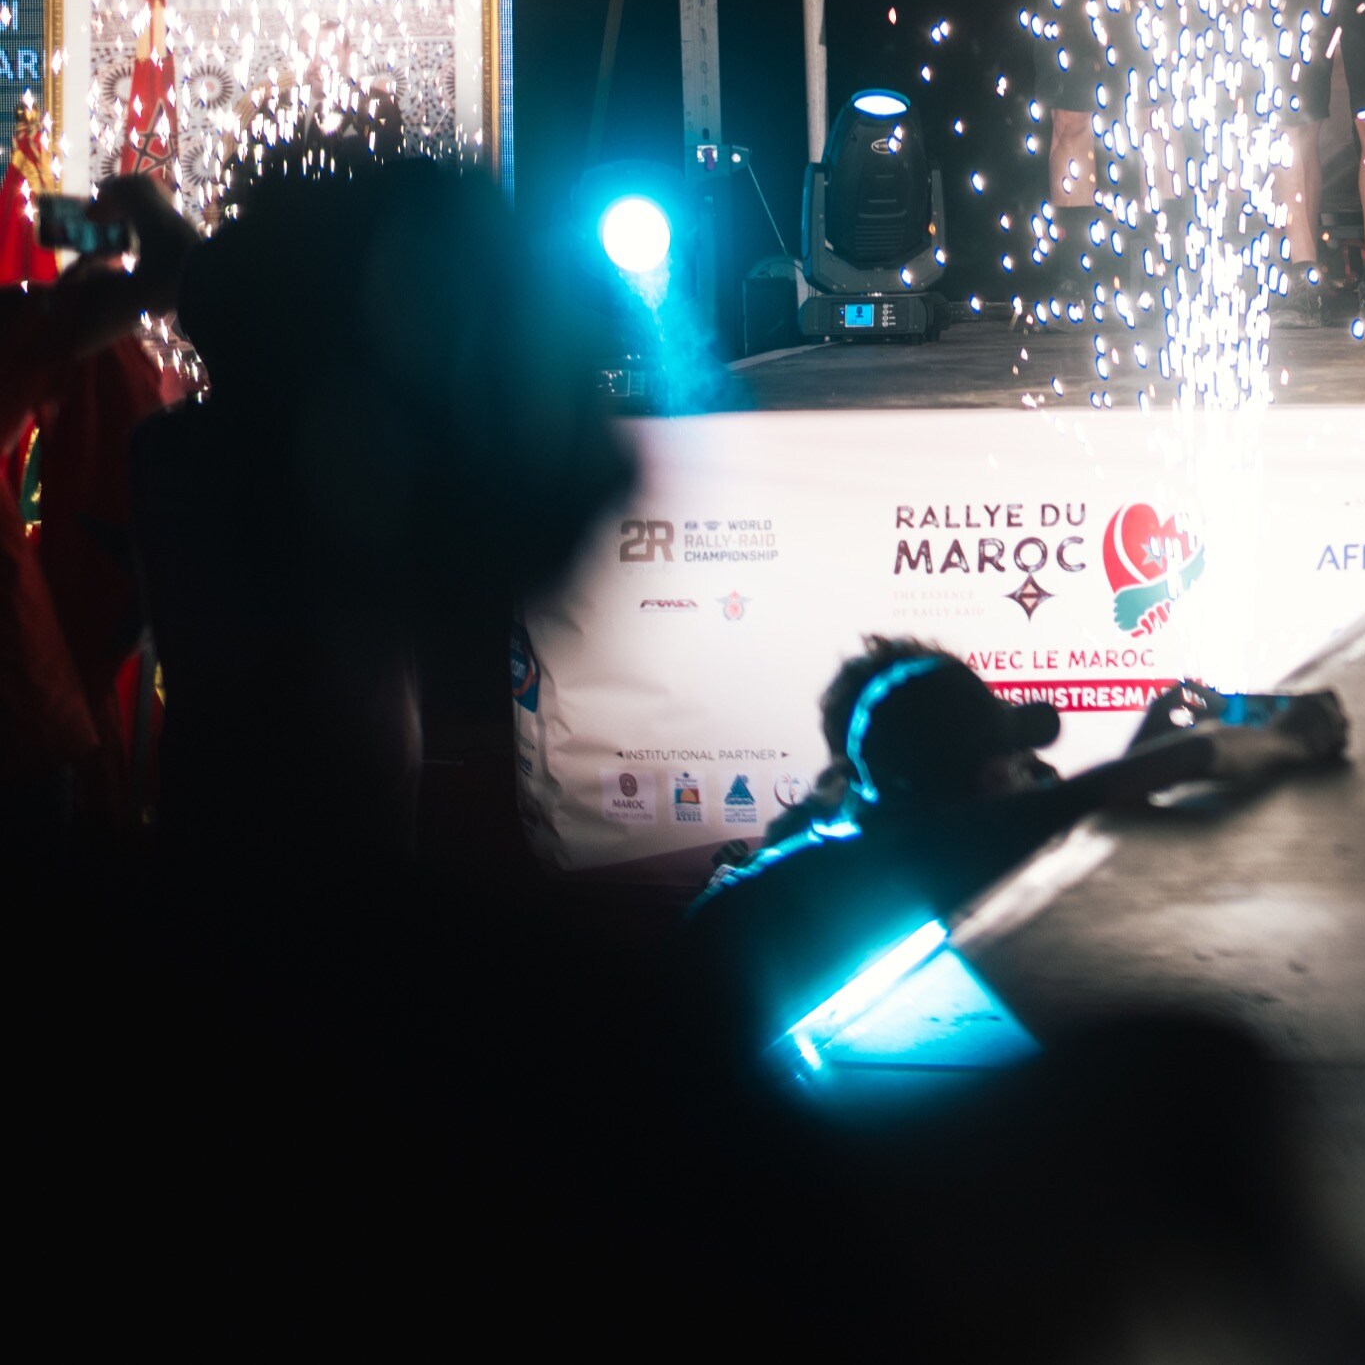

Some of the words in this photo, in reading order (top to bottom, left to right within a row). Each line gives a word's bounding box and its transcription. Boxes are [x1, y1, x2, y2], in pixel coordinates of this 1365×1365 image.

[895, 503, 1024, 528] RALLYE
[1040, 502, 1087, 527] DU
[728, 519, 773, 531] WORLD
[684, 533, 776, 548] RALLY-RAID
[684, 550, 779, 563] CHAMPIONSHIP
[894, 536, 1087, 574] MAROC
[966, 650, 1024, 671] AVEC
[1033, 650, 1058, 669] LE
[1068, 649, 1156, 669] MAROC
[625, 749, 715, 761] INSTITUTIONAL
[718, 748, 777, 761] PARTNER
[612, 799, 646, 810] MAROC
